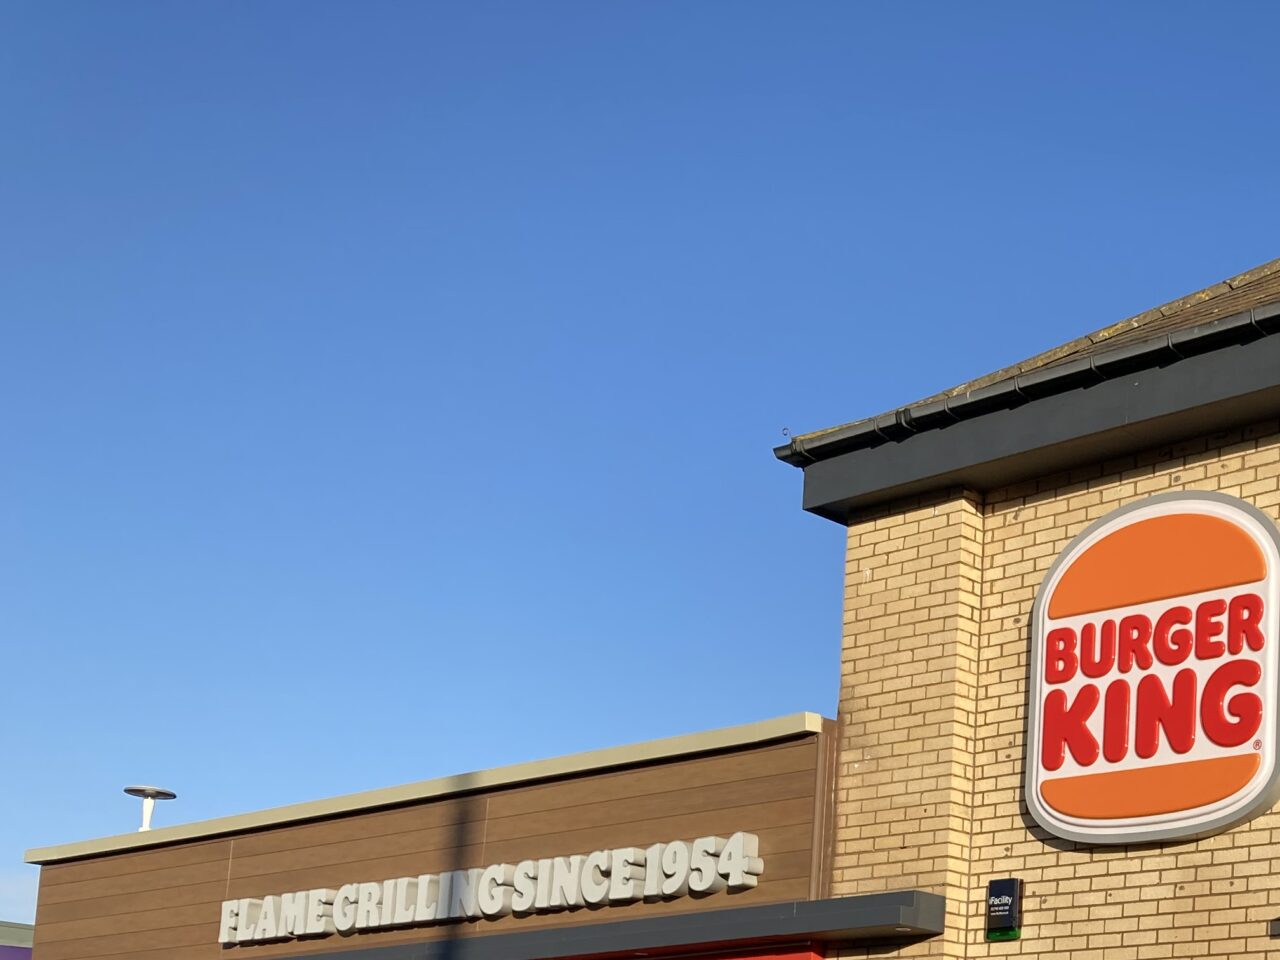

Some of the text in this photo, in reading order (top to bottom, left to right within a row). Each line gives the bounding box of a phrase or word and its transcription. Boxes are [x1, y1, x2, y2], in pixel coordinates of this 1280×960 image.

[1045, 593, 1265, 685] BURGER
[1041, 659, 1263, 771] KING
[218, 831, 757, 944] FLAME GRILLING SINCE 1954
